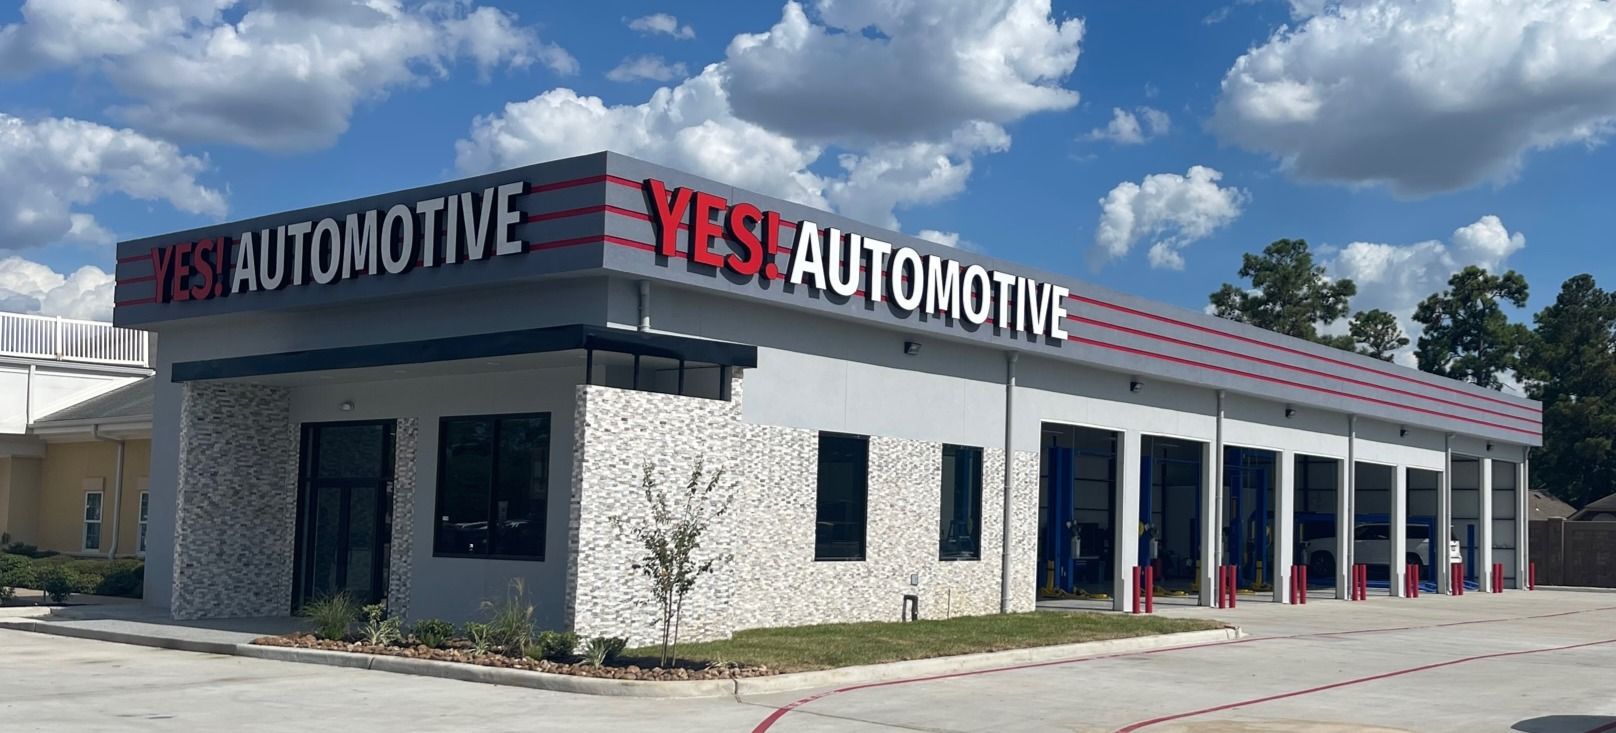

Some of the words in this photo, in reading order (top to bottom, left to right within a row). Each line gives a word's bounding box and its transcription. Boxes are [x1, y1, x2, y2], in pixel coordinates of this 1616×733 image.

[150, 236, 228, 303] YES!
[231, 181, 525, 294] AUTOMOTIVE
[646, 178, 781, 281] YES!
[789, 220, 1070, 341] AUTOMOTIVE
